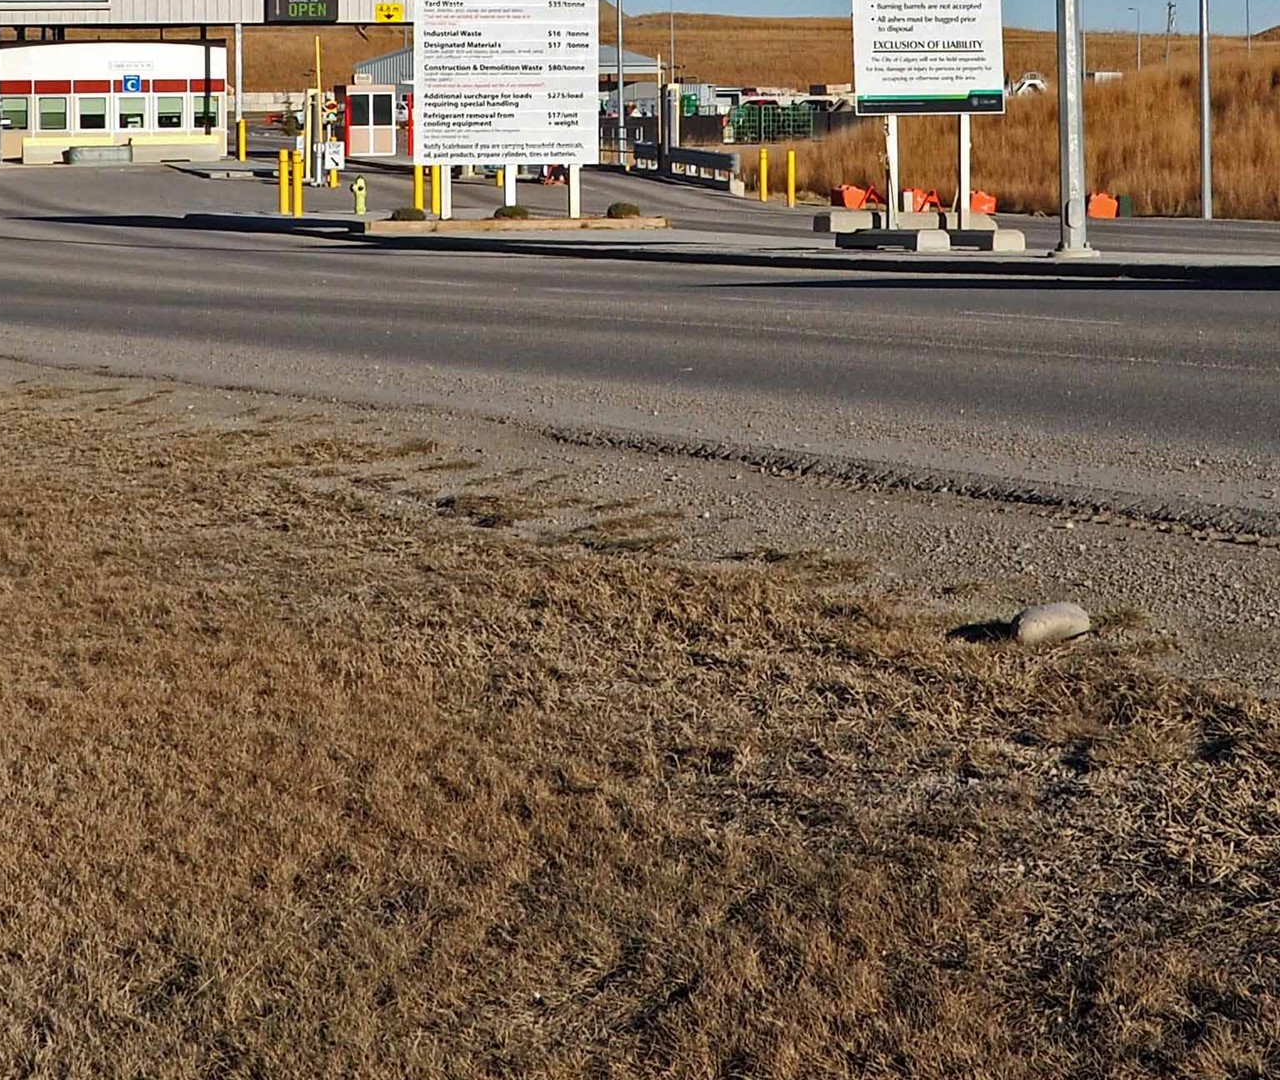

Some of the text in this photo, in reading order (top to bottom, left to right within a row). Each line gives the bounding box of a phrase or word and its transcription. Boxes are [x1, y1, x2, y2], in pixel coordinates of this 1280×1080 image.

[289, 3, 326, 17] OPEN
[424, 42, 465, 50] Designated
[874, 40, 983, 49] EXCLUSION OF LIABILITY
[464, 93, 499, 101] surcharge
[501, 93, 511, 101] for
[425, 101, 459, 109] requiring
[423, 112, 464, 120] Refrigerant
